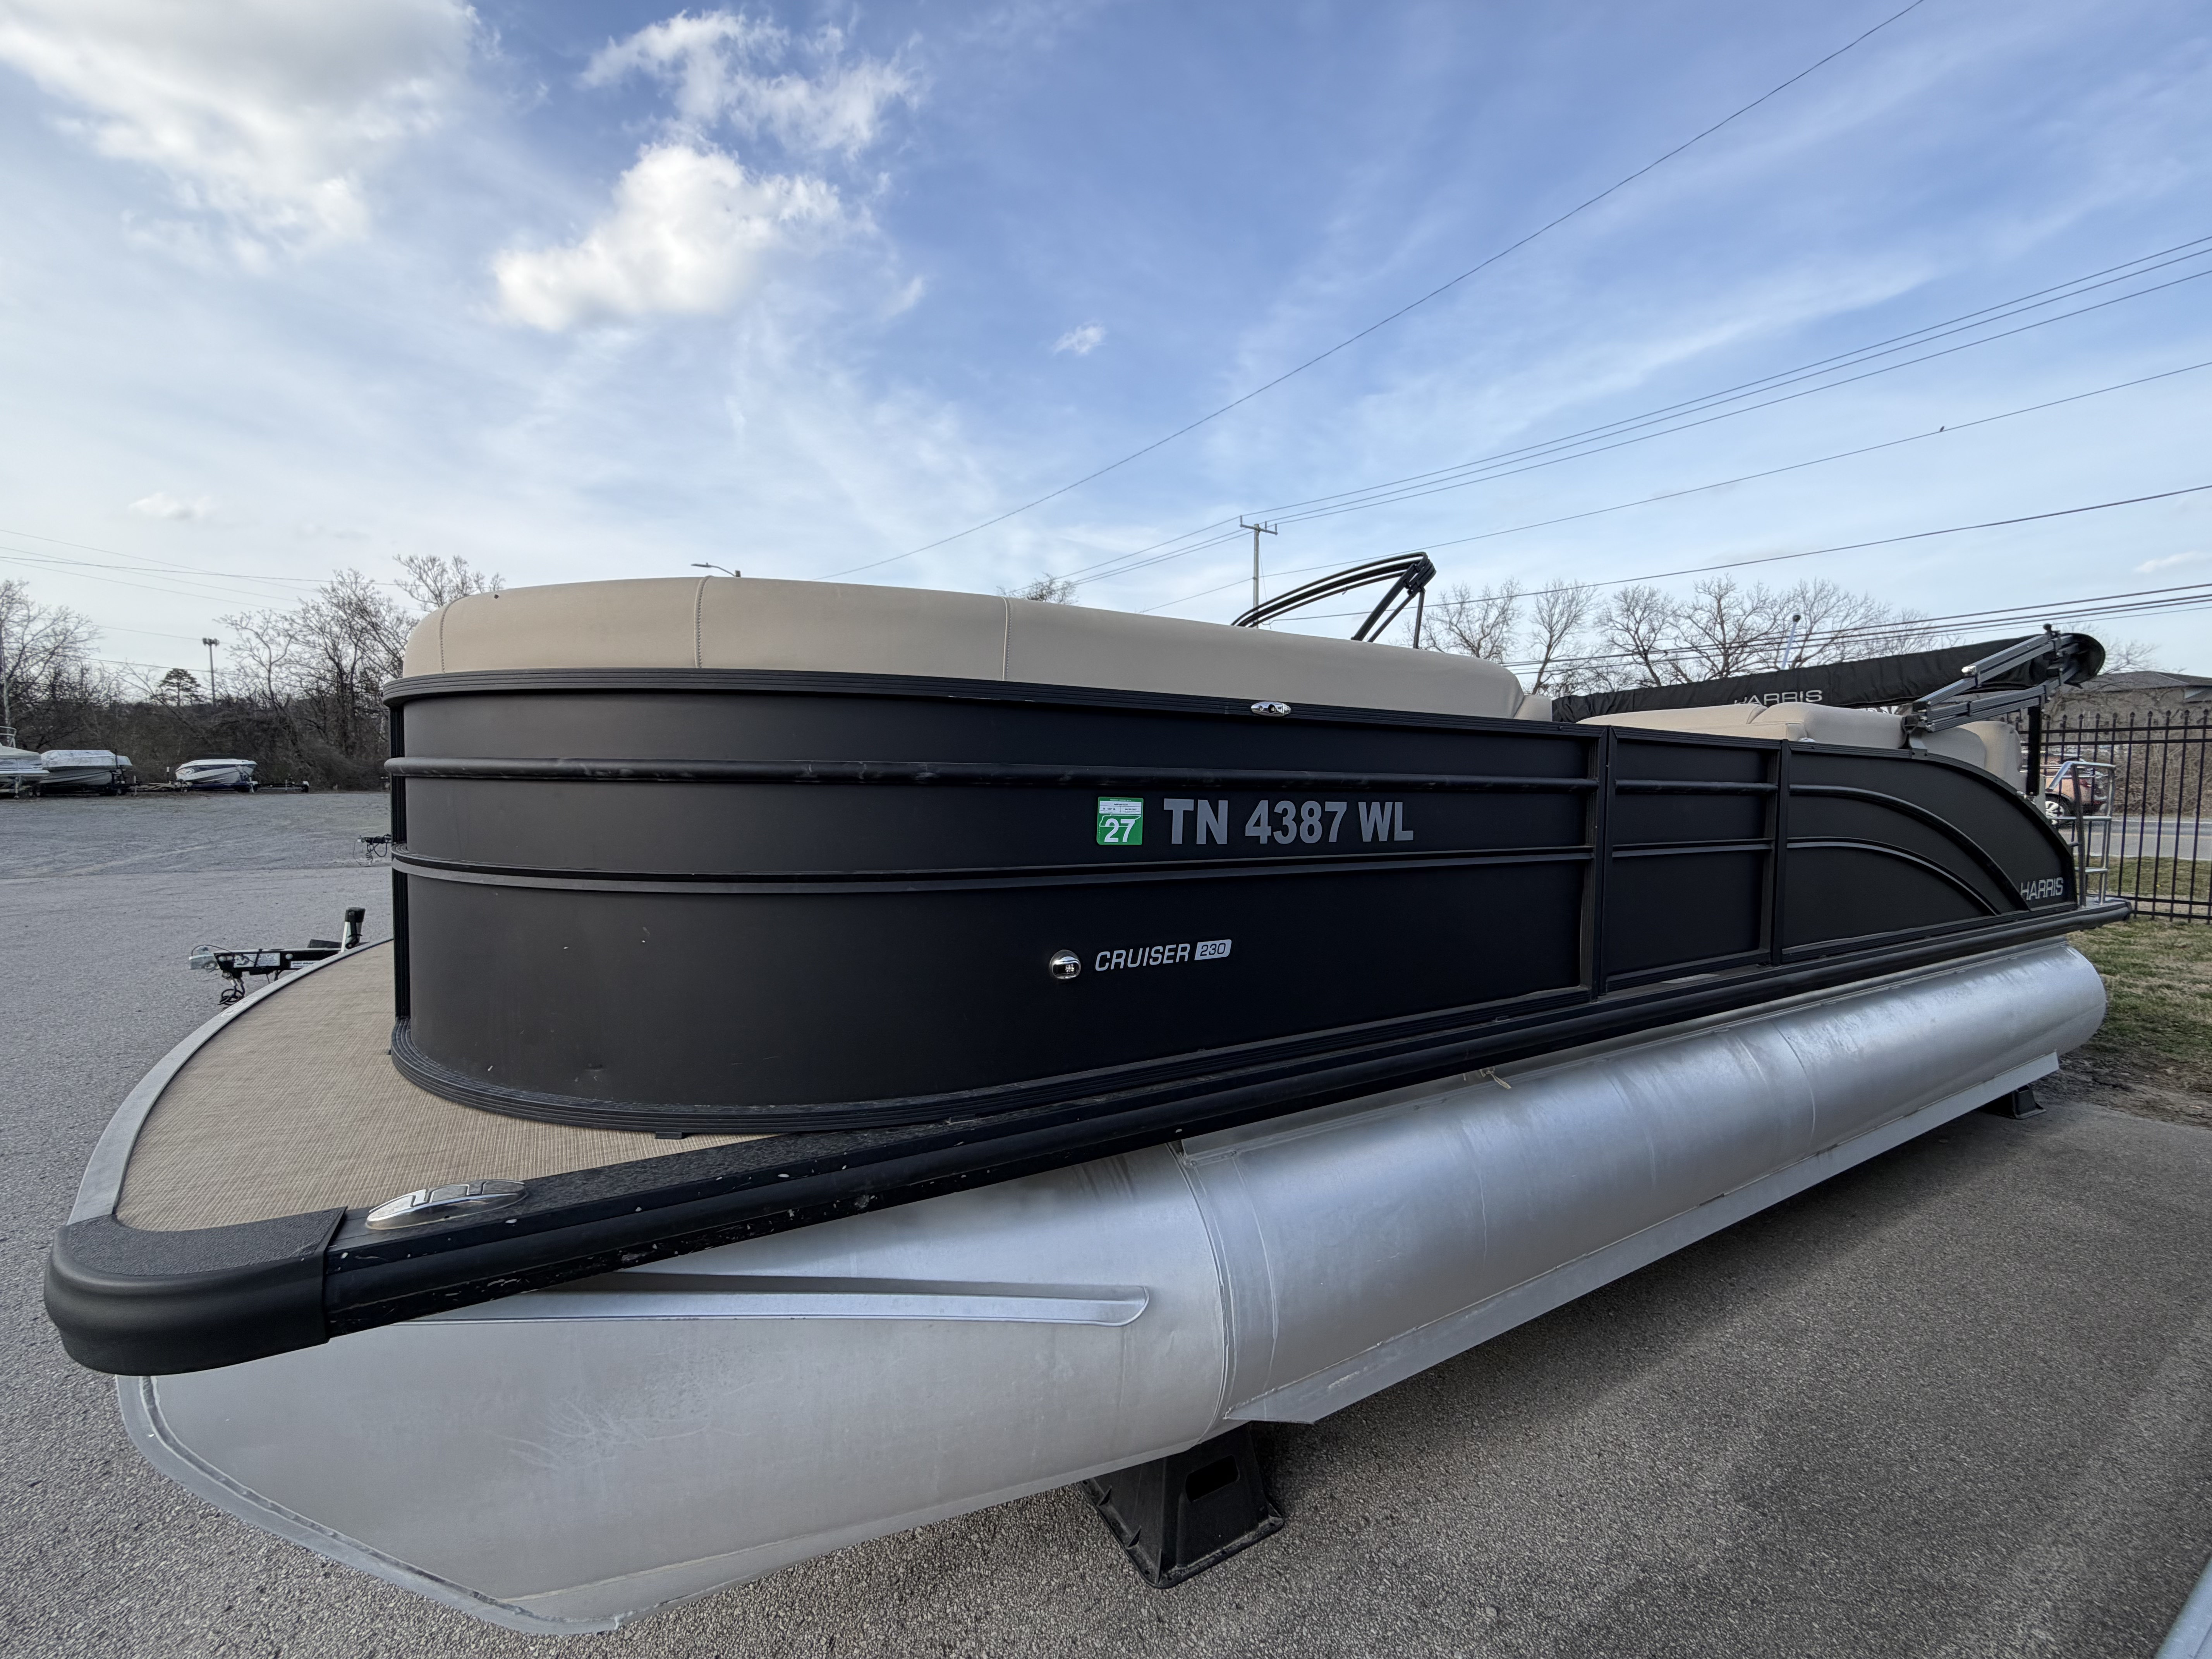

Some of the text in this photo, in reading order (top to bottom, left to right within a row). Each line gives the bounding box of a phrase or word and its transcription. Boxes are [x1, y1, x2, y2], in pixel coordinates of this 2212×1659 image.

[1104, 818, 1135, 843] 27
[1163, 798, 1414, 845] TN 4387 WL
[2021, 877, 2064, 900] HARRIS
[1095, 942, 1226, 972] CRUISER 230
